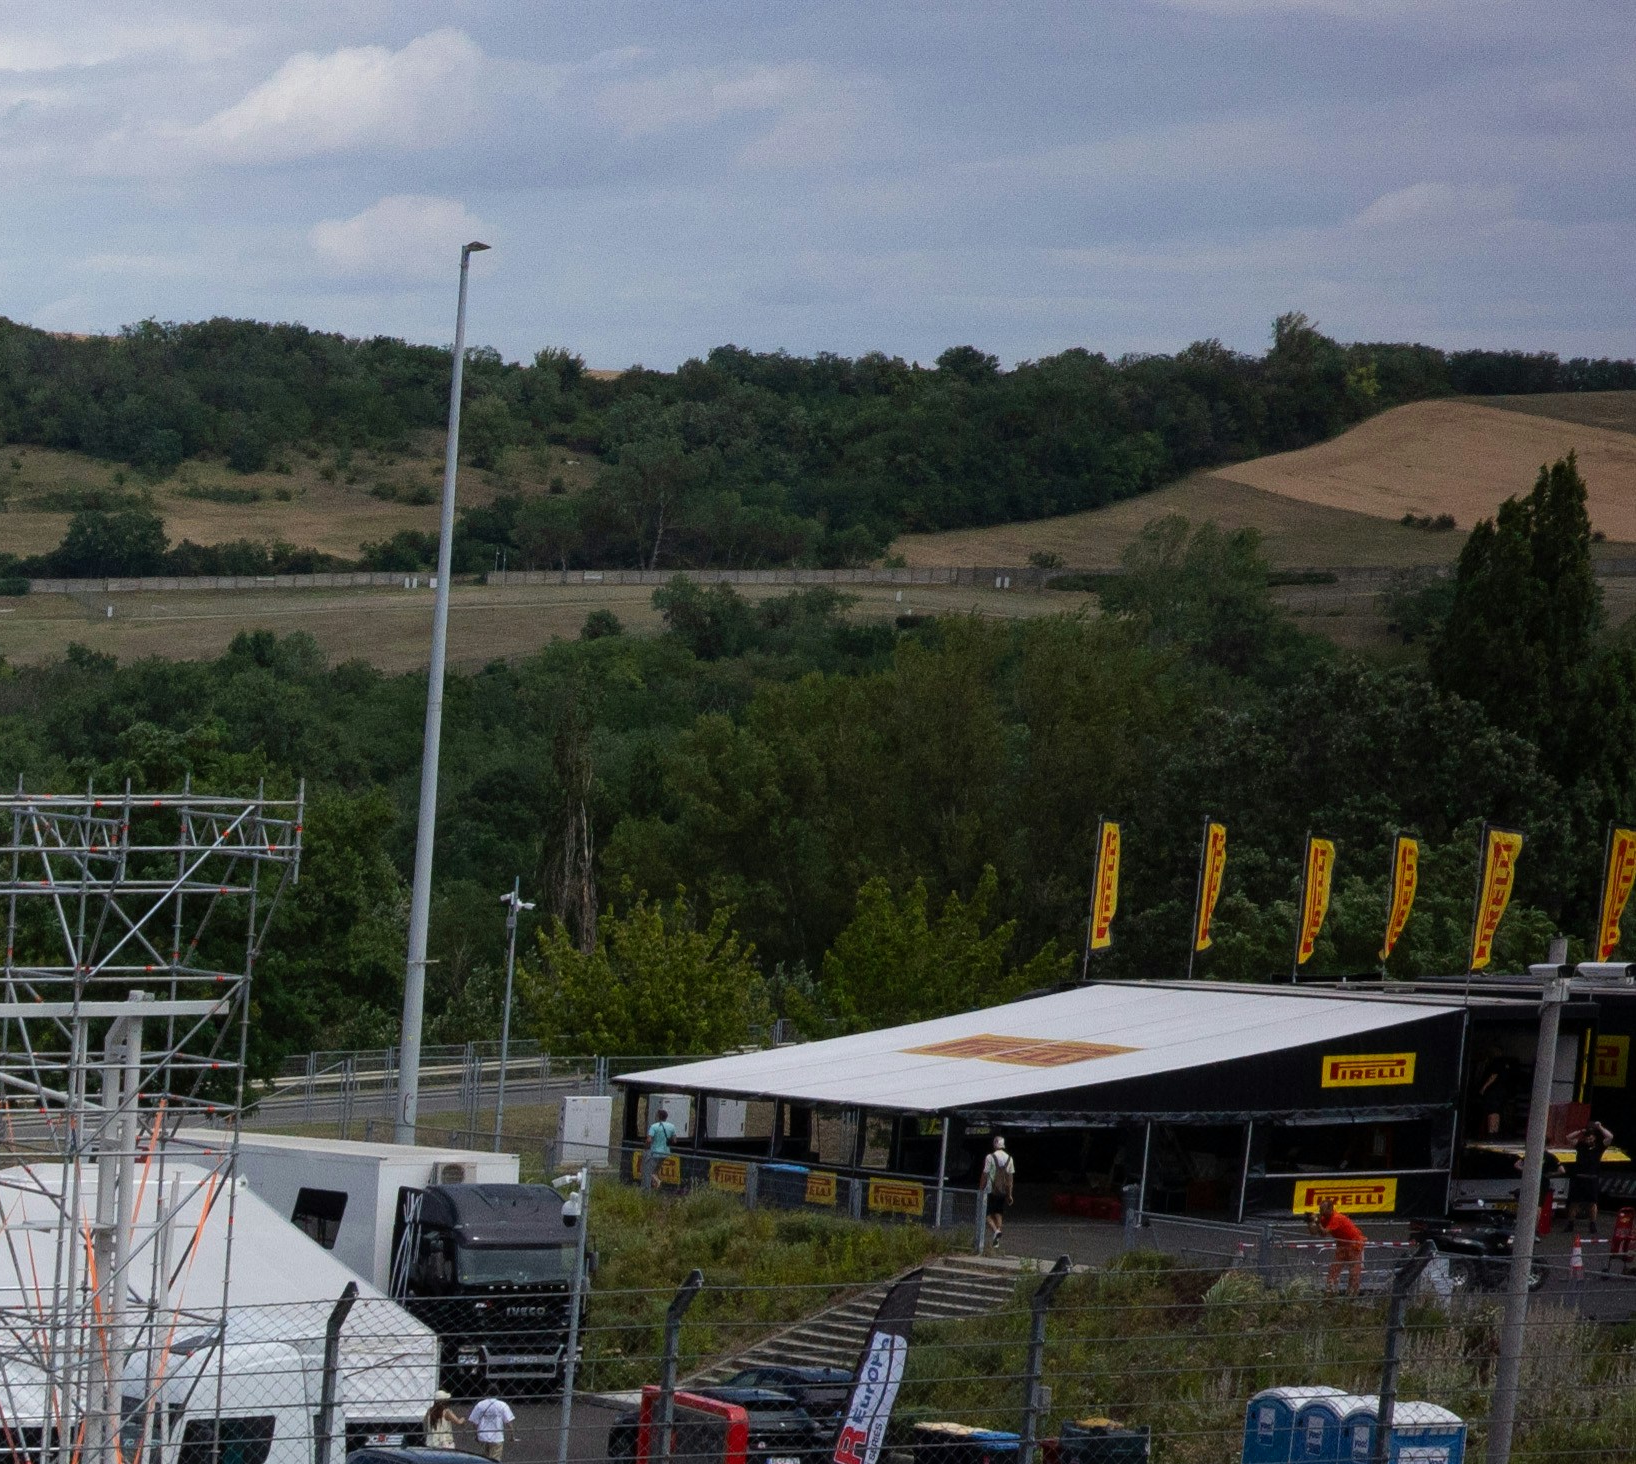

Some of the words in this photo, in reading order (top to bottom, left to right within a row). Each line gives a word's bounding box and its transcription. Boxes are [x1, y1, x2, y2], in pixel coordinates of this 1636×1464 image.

[1330, 1059, 1407, 1080] PIRELLI
[873, 1184, 920, 1207] PIRELLI
[506, 1306, 546, 1316] IVECO
